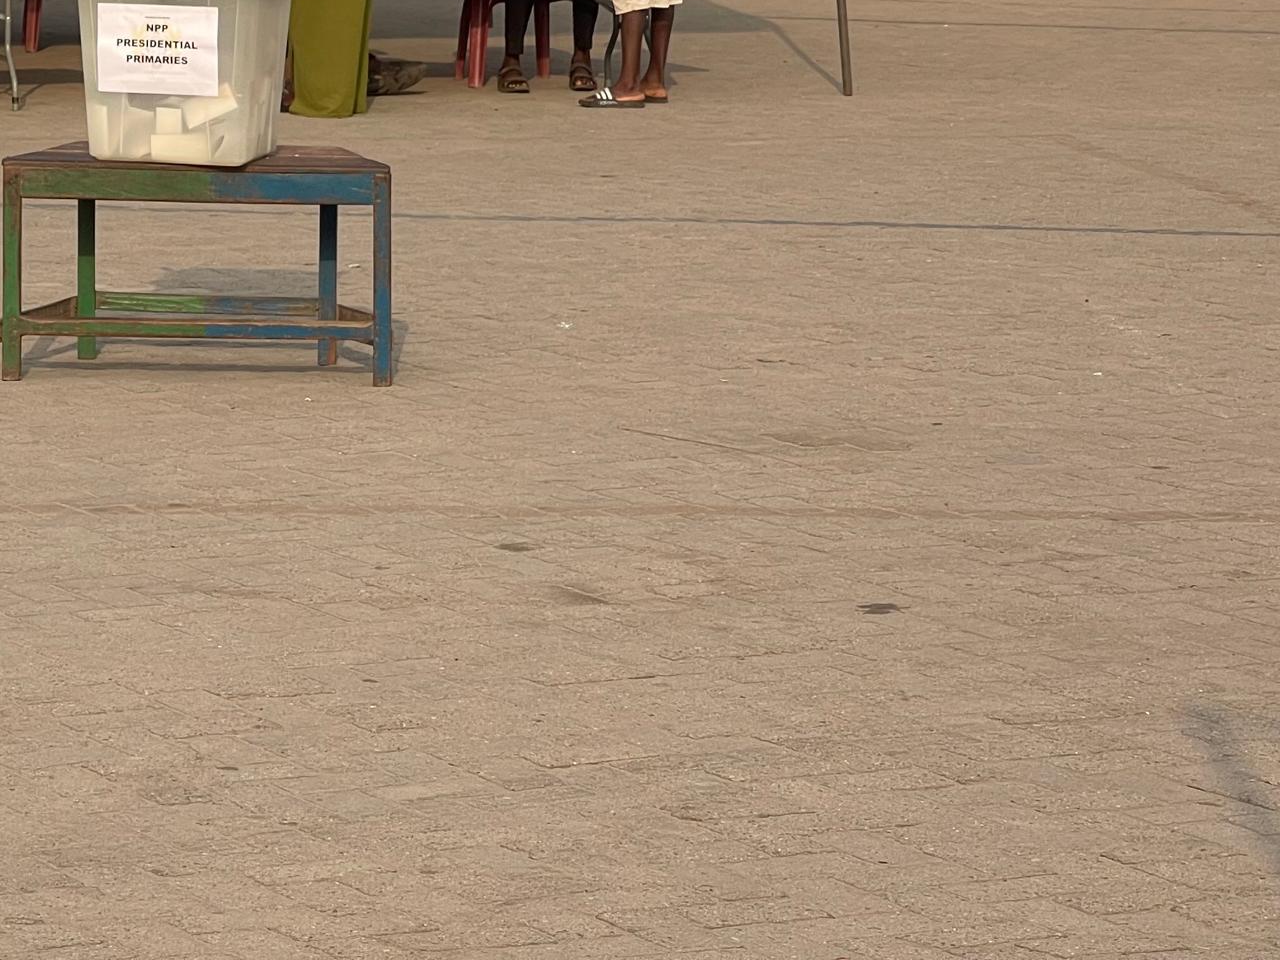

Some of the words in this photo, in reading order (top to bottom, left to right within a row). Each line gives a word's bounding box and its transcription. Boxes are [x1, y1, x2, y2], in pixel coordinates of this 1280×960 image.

[146, 24, 168, 32] NPP
[116, 38, 198, 49] PRESIDENTIAL
[126, 55, 188, 64] PRIMARIES
